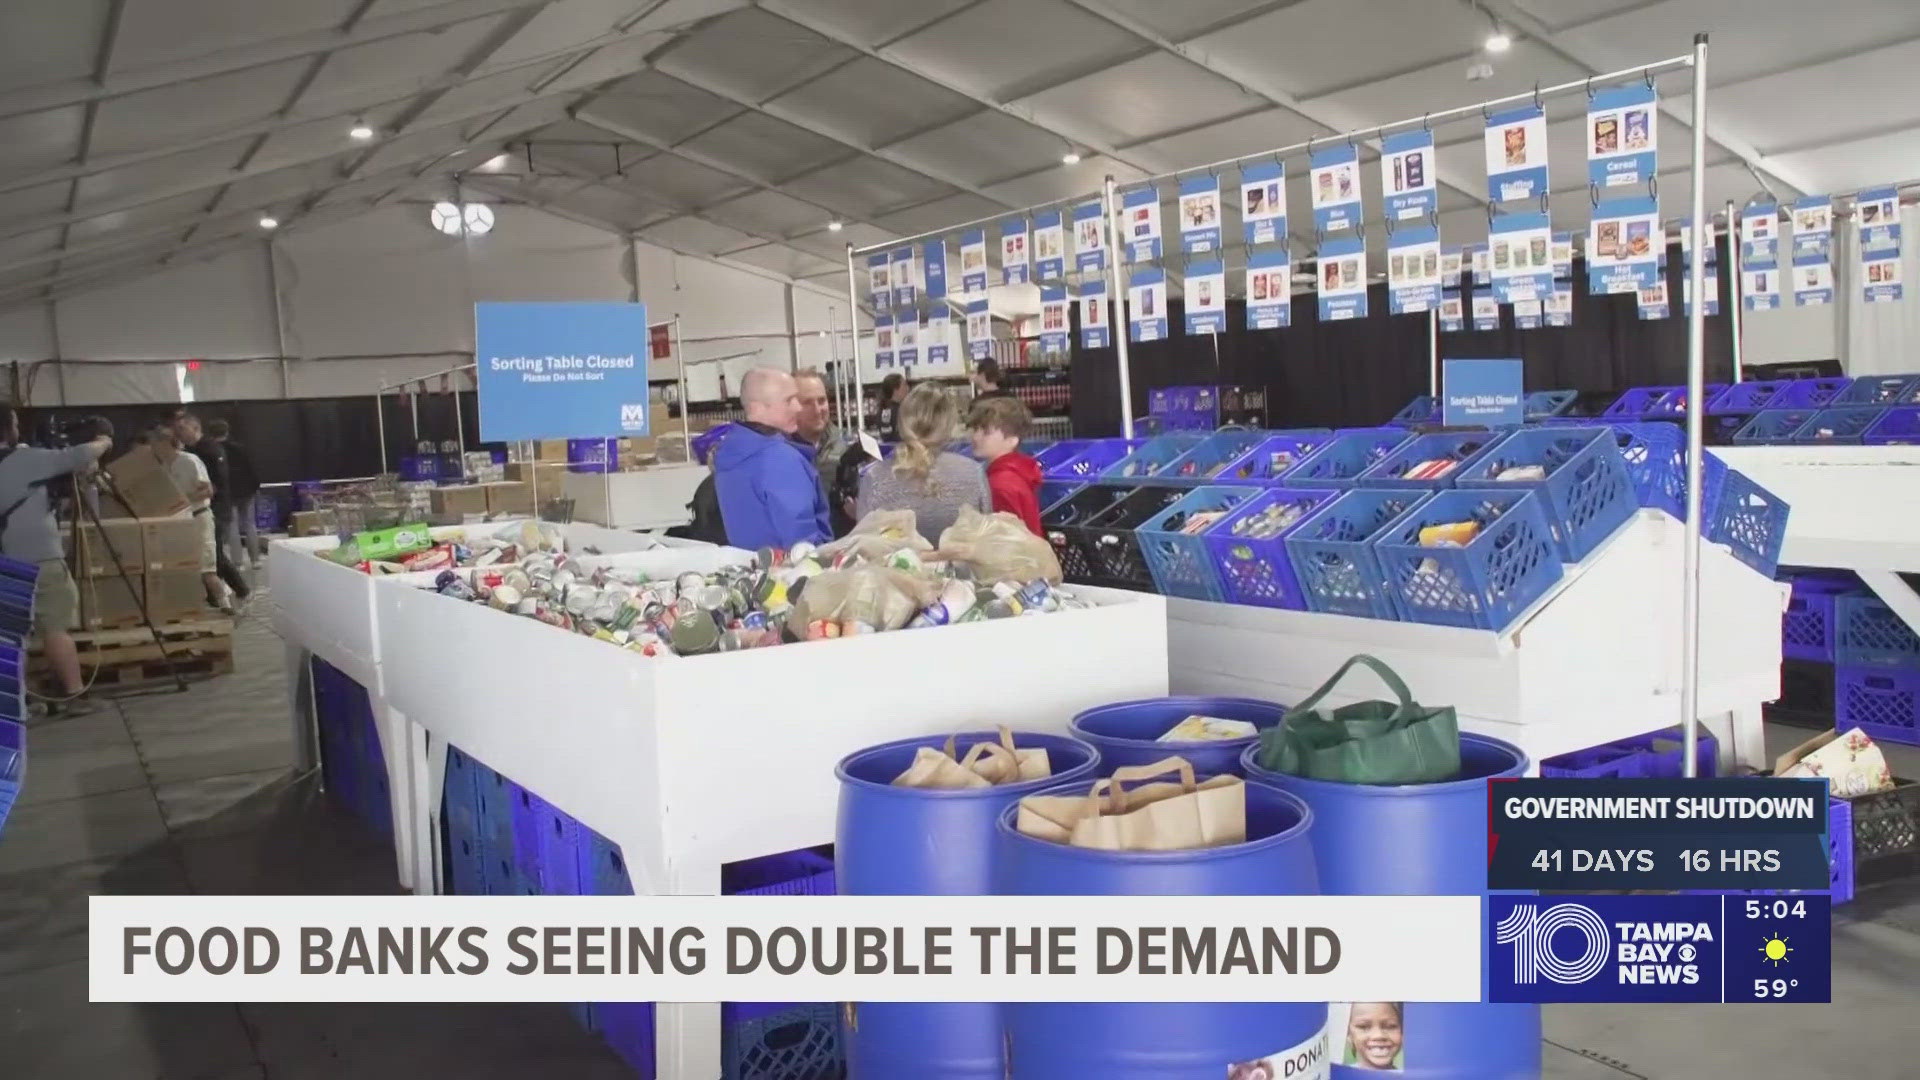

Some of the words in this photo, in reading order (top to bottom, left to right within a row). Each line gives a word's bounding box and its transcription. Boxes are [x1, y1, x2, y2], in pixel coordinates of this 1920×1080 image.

[491, 356, 543, 373] Sorting
[545, 355, 584, 369] Table
[586, 354, 634, 369] Closed
[523, 373, 551, 382] Please
[553, 373, 566, 381] Do
[567, 372, 584, 380] Not
[585, 371, 604, 380] Sort
